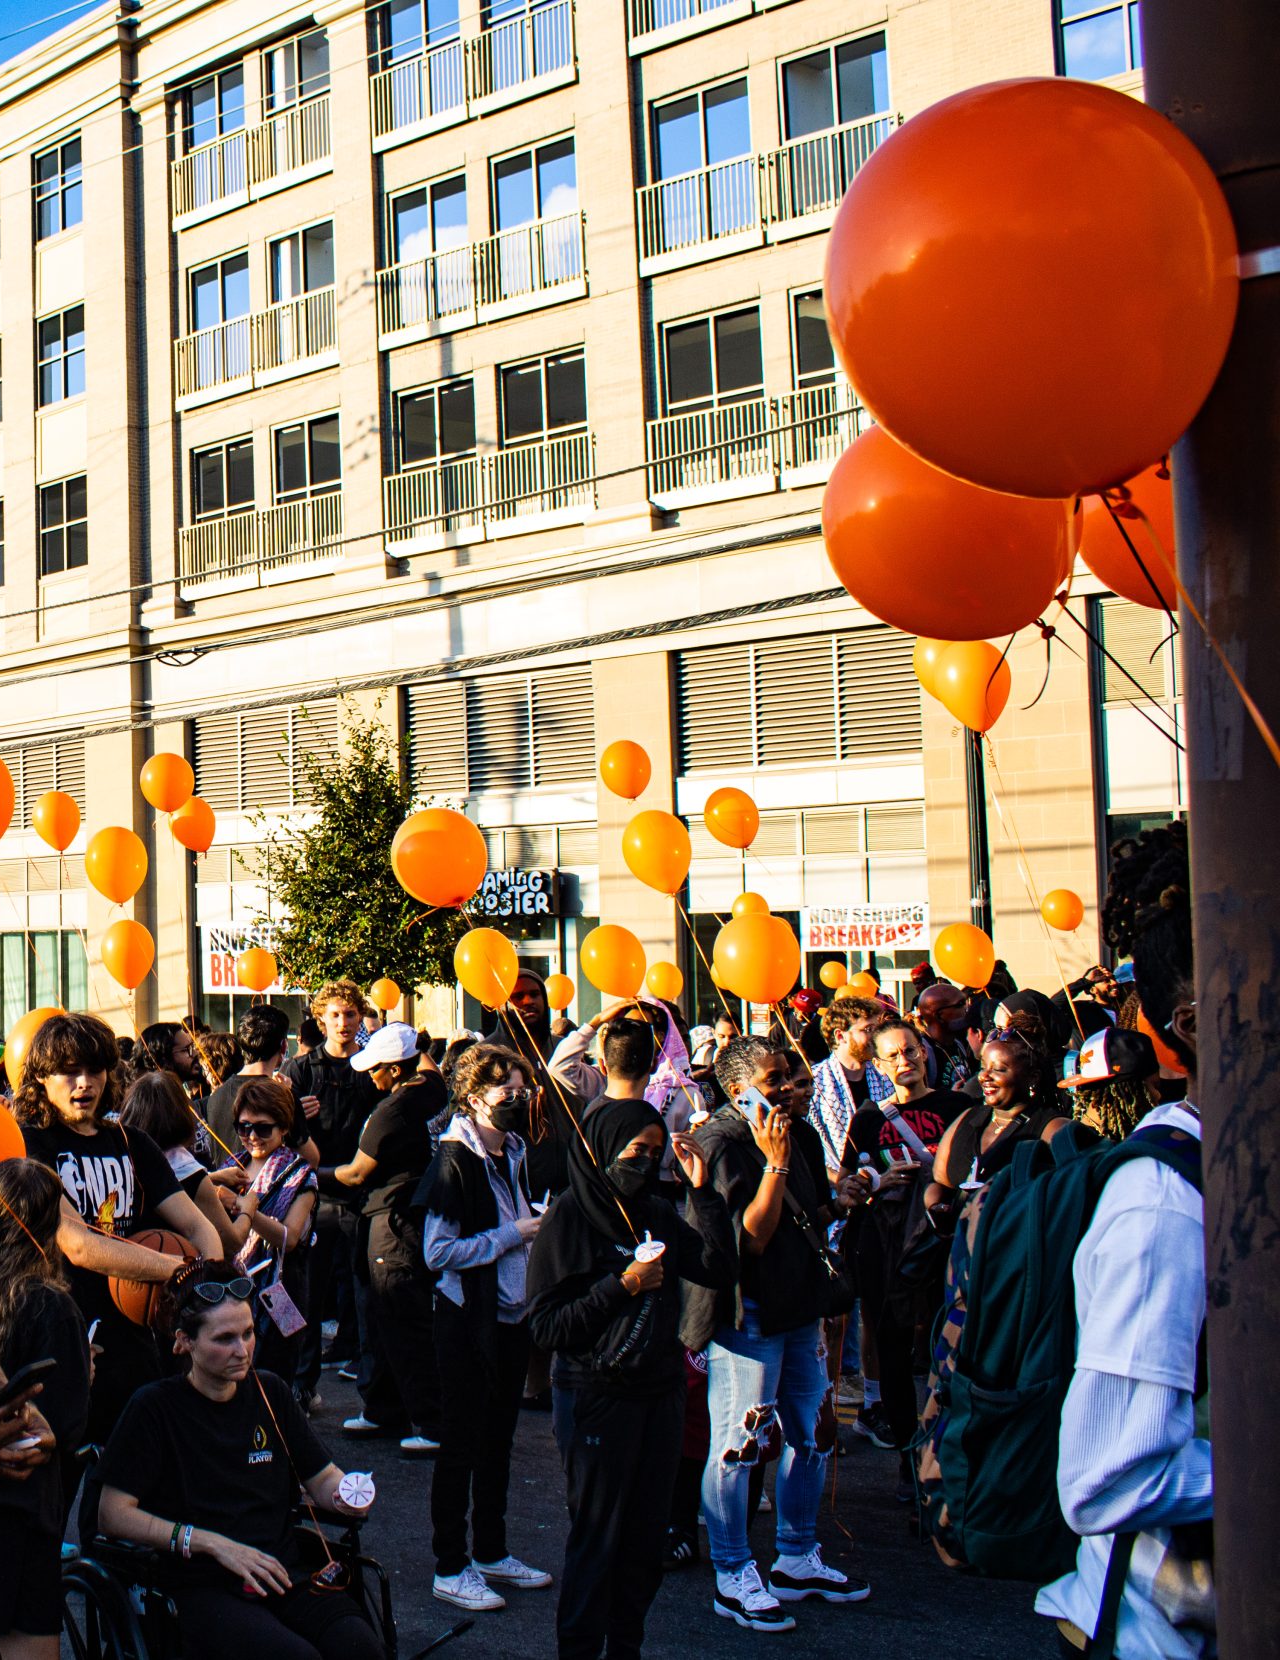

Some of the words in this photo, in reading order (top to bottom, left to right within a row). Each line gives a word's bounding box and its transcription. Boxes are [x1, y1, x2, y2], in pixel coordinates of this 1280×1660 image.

[809, 908, 847, 923] NOW
[809, 923, 924, 947] BREAKFAST
[81, 1155, 134, 1218] NBA
